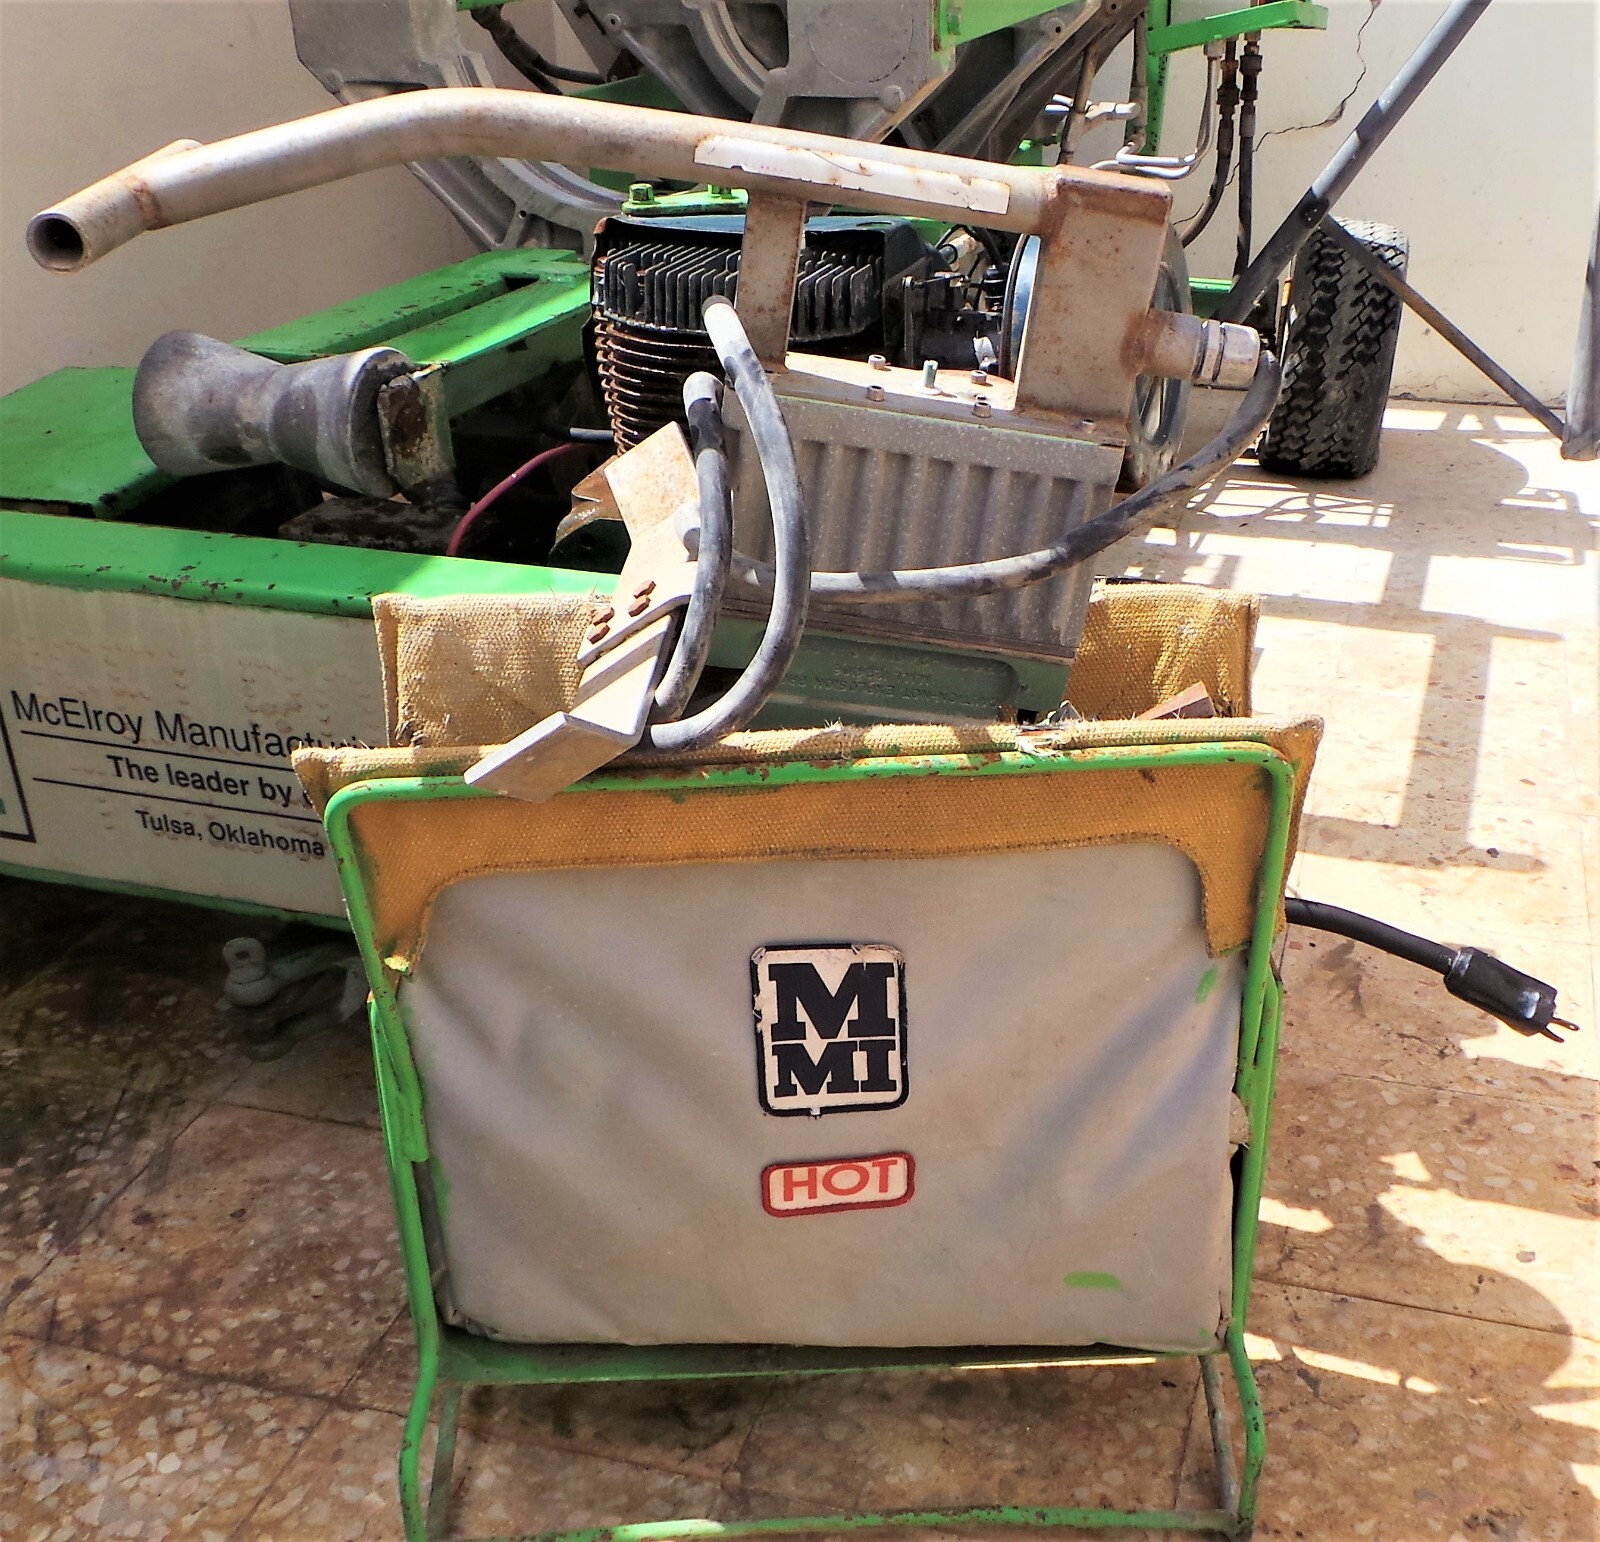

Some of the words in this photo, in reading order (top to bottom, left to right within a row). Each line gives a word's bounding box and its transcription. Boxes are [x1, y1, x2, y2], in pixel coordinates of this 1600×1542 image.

[11, 690, 142, 744] McElroy
[107, 755, 160, 783] The
[167, 763, 250, 796] leader
[260, 777, 292, 807] by
[135, 809, 203, 841] Tulsa,
[208, 820, 325, 857] Oklahoma
[768, 962, 896, 1041] M
[772, 1039, 897, 1098] MI
[782, 1159, 898, 1202] HOT
